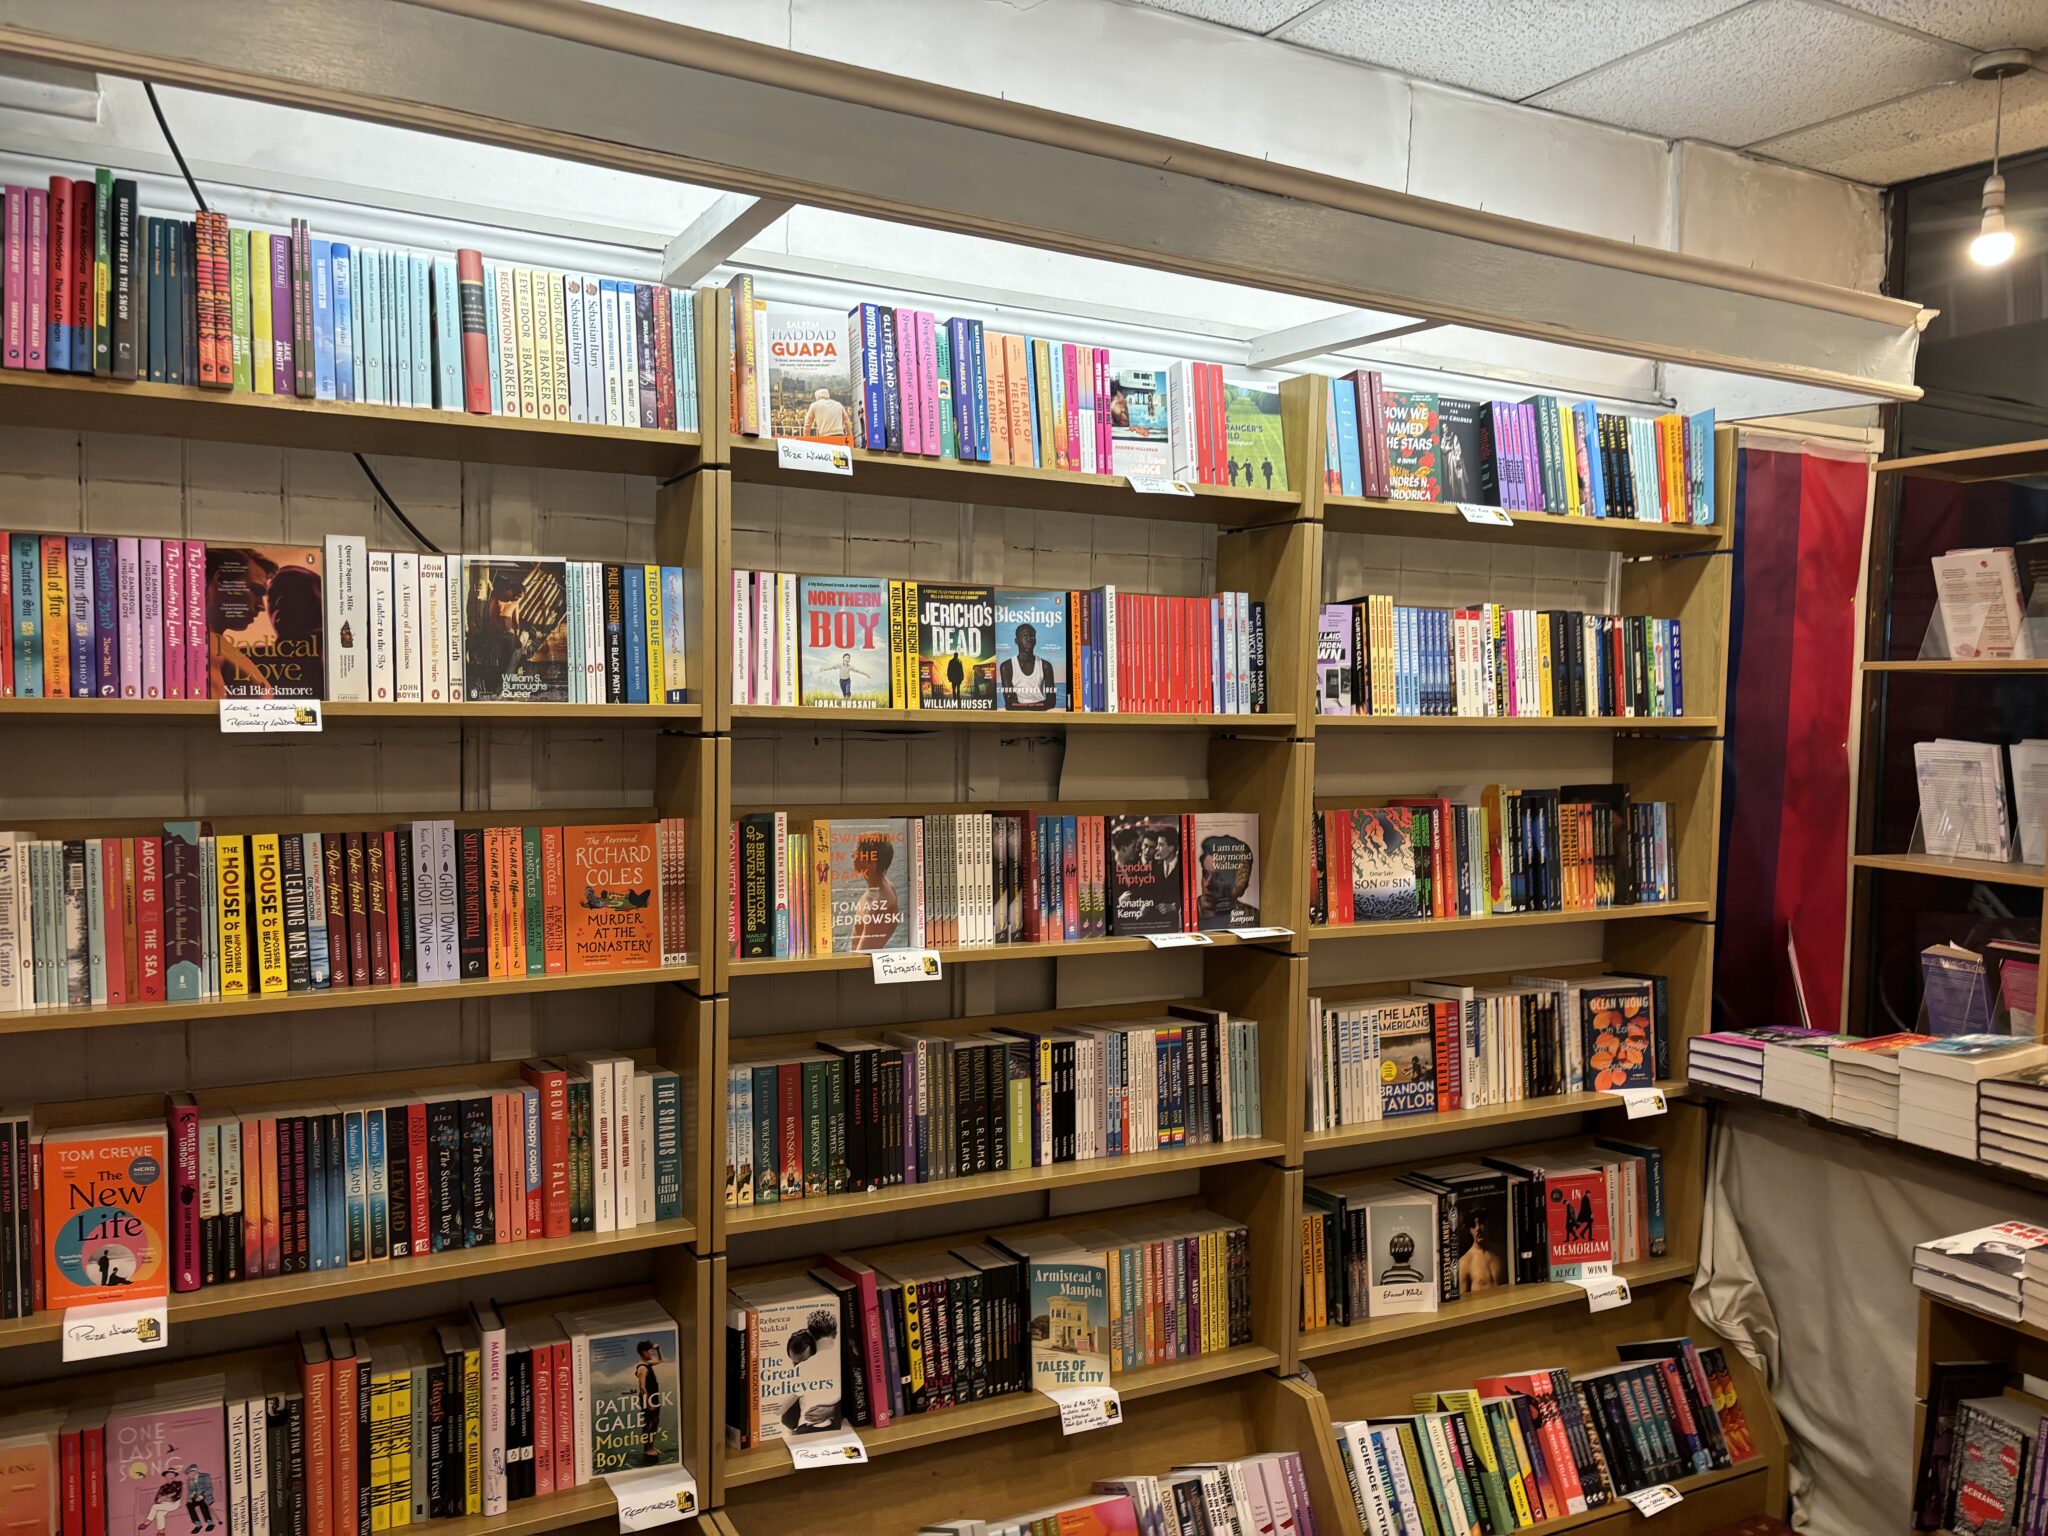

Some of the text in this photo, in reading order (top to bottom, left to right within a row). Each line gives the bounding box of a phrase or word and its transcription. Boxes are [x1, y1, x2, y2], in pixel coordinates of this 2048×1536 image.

[212, 213, 228, 258] PERFECT
[119, 198, 129, 319] BUILDING FIRES IN THE SNOW
[276, 239, 285, 286] TRUECRIME
[54, 198, 64, 342] Pedro Almodóvar The Last Dream
[215, 299, 231, 341] ANGELS
[500, 272, 515, 397] REGENERATION BARKER
[772, 329, 837, 340] HADDAD
[866, 306, 878, 385] BOYFRIEND MATERIAL
[772, 342, 838, 356] GUAPA
[883, 315, 894, 387] GLITTERLAND
[1411, 408, 1427, 420] WE
[1387, 422, 1424, 435] NAMED
[1386, 437, 1432, 451] HE STARS
[189, 548, 201, 561] The
[608, 567, 618, 587] PAUL
[609, 590, 619, 624] BURSTON
[649, 571, 659, 646] TIEPOLO BLUE
[808, 590, 881, 608] NORTHERN
[190, 606, 201, 619] Mr
[891, 587, 903, 653] KILLING JERICHO
[921, 602, 993, 626] JERICHO'S
[995, 605, 1063, 626] Blessings
[808, 610, 881, 649] BOY
[216, 632, 318, 658] Radical
[932, 627, 981, 657] DEAD
[611, 647, 620, 672] BLACK
[233, 661, 302, 682] Love
[501, 673, 529, 683] William
[224, 684, 313, 697] Neil Blackmore
[502, 681, 547, 692] Burroughs
[502, 688, 530, 699] Queer
[924, 699, 992, 709] WILLIAM HUSSEY
[576, 848, 651, 865] RICHARD
[1116, 862, 1152, 873] London
[259, 855, 277, 915] HOUSE
[585, 868, 643, 887] COLES
[746, 826, 756, 931] OF SEVEN KILLINGS
[756, 832, 765, 923] A BRIEF HISTORY
[1116, 873, 1156, 886] Triptych
[1354, 879, 1378, 890] SON
[1392, 878, 1411, 888] SIN
[142, 841, 158, 977] ABOVE US THE SEA
[439, 874, 456, 944] GHOST TOWN
[832, 900, 888, 912] TOMASZ
[1116, 898, 1154, 908] Jonathan
[1117, 908, 1143, 920] Kemp
[262, 919, 278, 927] OF
[285, 873, 307, 959] LEADING MEN
[588, 915, 643, 926] MURDER
[593, 927, 636, 938] AT THE
[263, 931, 272, 970] BEAUTIES
[272, 930, 281, 969] IMPOSSIBLE
[577, 943, 653, 953] MONASTERY
[1378, 1005, 1428, 1021] THE LATE
[1590, 996, 1648, 1010] OCEAN VUONG
[1378, 1019, 1429, 1031] AMERICANS
[918, 1052, 927, 1116] COBALT BLUE
[1381, 1080, 1434, 1096] BRANDON
[1382, 1094, 1435, 1112] TAYLOR
[658, 1083, 676, 1155] THE SHARDS
[525, 1098, 540, 1183] the happy couple
[550, 1079, 566, 1198] GROW FALL
[761, 1118, 770, 1168] WOLFSONG
[786, 1116, 796, 1169] RAVENSONG
[811, 1115, 820, 1167] HEARTSONG
[58, 1145, 153, 1162] TOM CREWE
[178, 1137, 188, 1168] LONDON
[186, 1123, 197, 1180] CURSED UNDER
[97, 1170, 122, 1182] The
[69, 1182, 147, 1210] New
[1571, 1189, 1581, 1200] IN
[78, 1211, 143, 1242] Life
[1553, 1241, 1609, 1257] MEMORIAM
[1035, 1269, 1092, 1284] Armistead
[1060, 1282, 1103, 1298] Maupin
[491, 1341, 499, 1381] MAURICE
[761, 1356, 783, 1368] The
[1037, 1359, 1086, 1373] TALES OF
[761, 1367, 800, 1381] Great
[1055, 1371, 1104, 1384] THE CITY
[466, 1371, 478, 1421] CONFIDENCE
[761, 1378, 834, 1398] Believers
[336, 1369, 353, 1452] Rupert Everett
[596, 1391, 674, 1417] PATRICK
[595, 1412, 647, 1433] GALE
[118, 1422, 166, 1446] ONE
[391, 1379, 411, 1502] AN HONEST MAN
[596, 1427, 668, 1451] Mother's
[120, 1441, 162, 1464] LAST
[596, 1452, 627, 1468] Boy
[119, 1456, 184, 1482] SONG
[1358, 1437, 1391, 1536] SCIENCE FICTIO
[1962, 1484, 2005, 1512] SCREAMING
